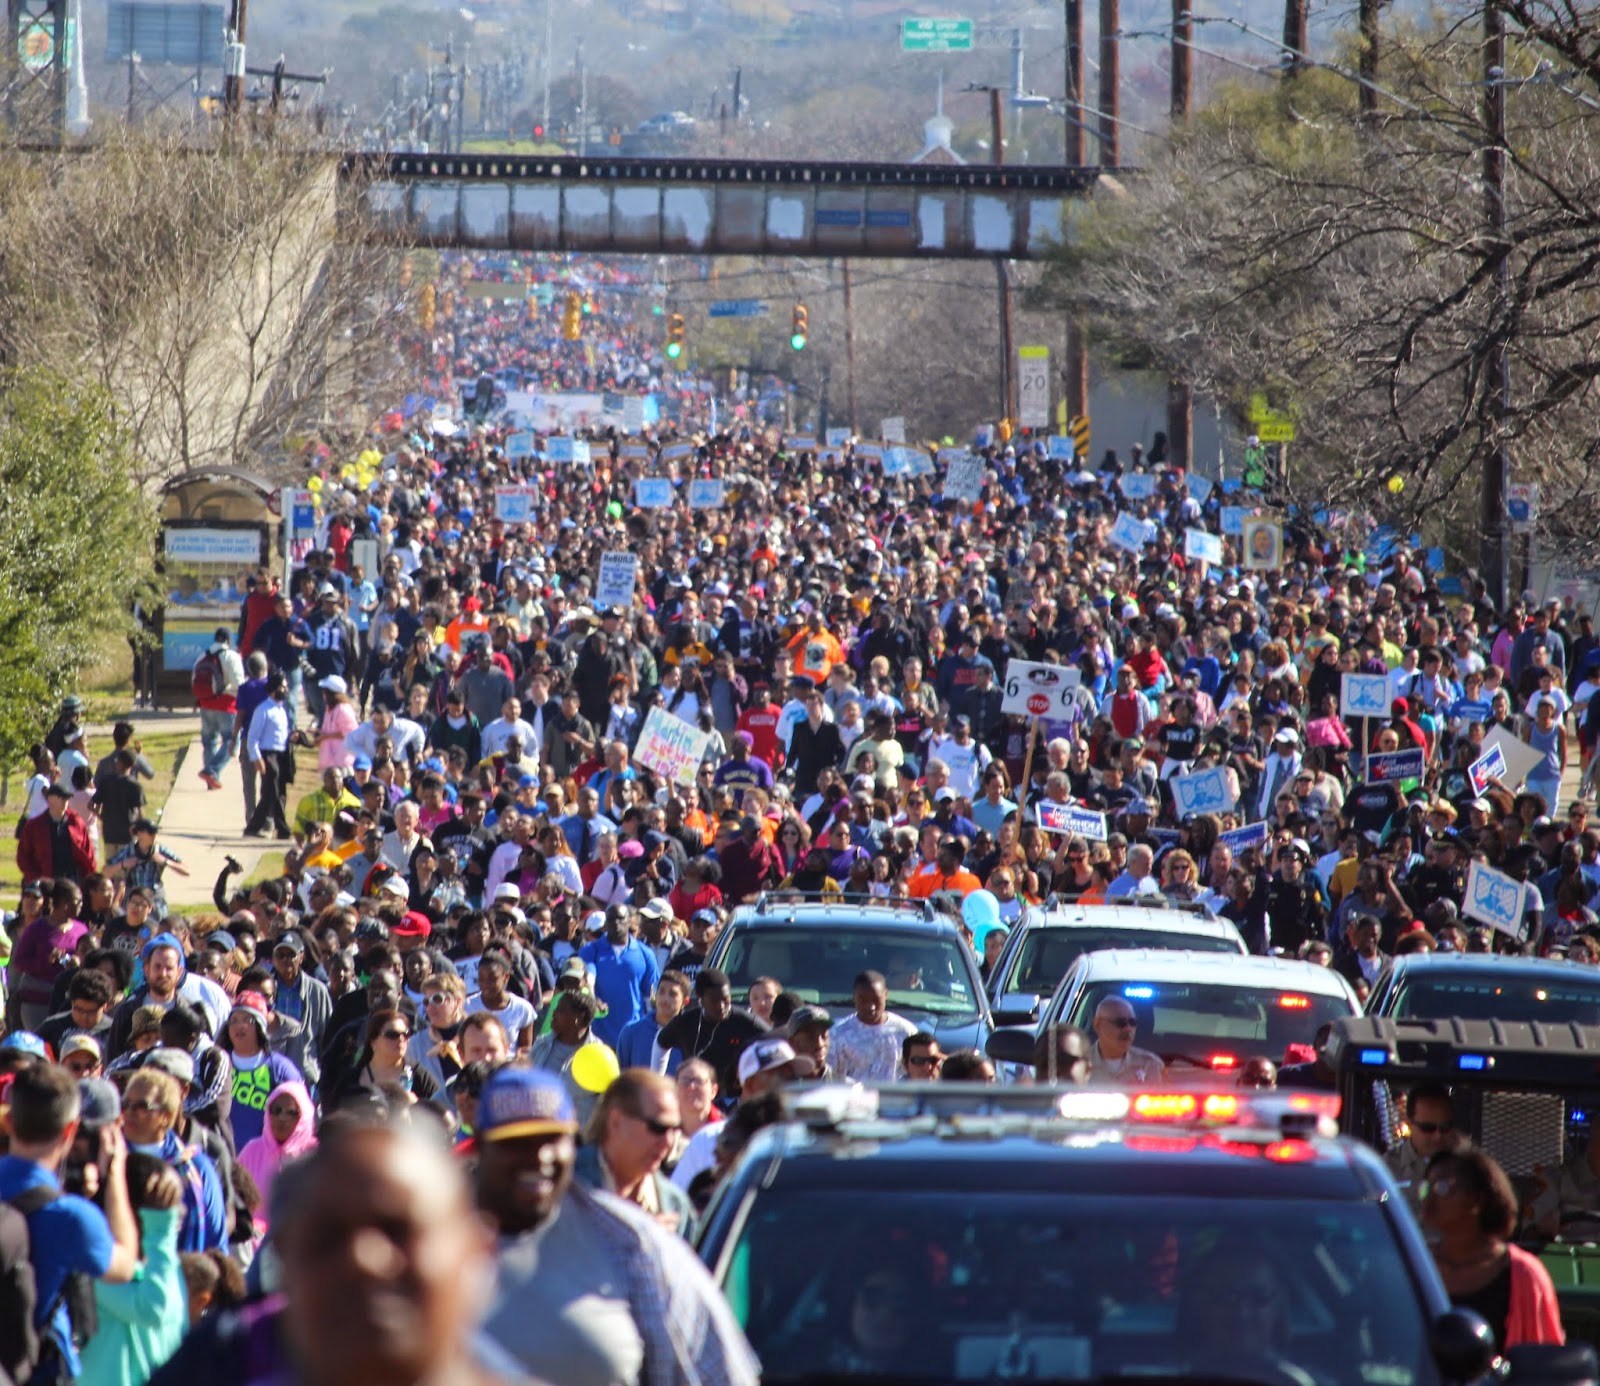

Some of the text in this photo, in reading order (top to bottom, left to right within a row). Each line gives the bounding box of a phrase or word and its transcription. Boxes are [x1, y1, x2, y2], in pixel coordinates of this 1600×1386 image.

[1024, 374, 1045, 391] 20
[316, 627, 340, 650] 81
[1007, 676, 1019, 698] 6
[1061, 686, 1075, 707] 6
[1028, 699, 1049, 710] STOP
